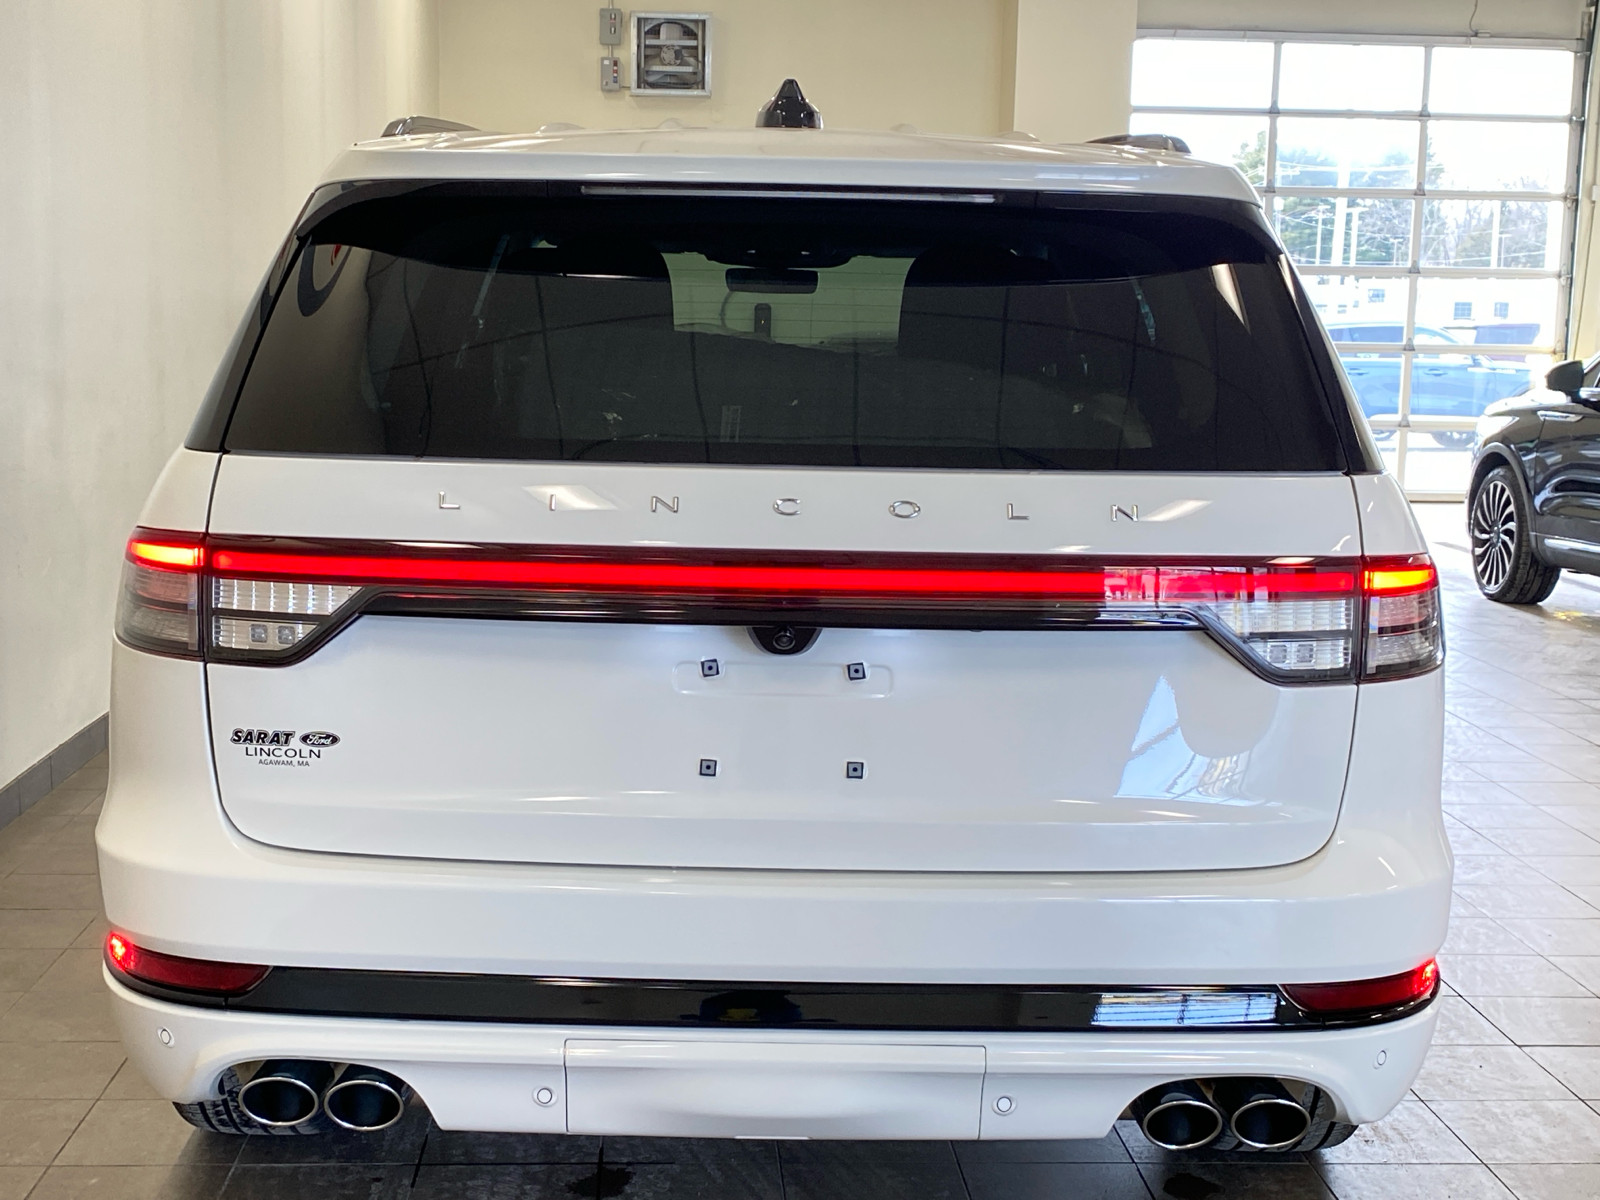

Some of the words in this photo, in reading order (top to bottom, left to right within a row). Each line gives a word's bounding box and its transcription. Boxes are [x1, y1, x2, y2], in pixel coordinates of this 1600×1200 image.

[438, 490, 1139, 522] LINCOLN
[230, 728, 296, 746] SARAT
[306, 734, 332, 745] Ford
[245, 747, 321, 758] LINCOLN
[258, 759, 296, 767] AGAWAM,
